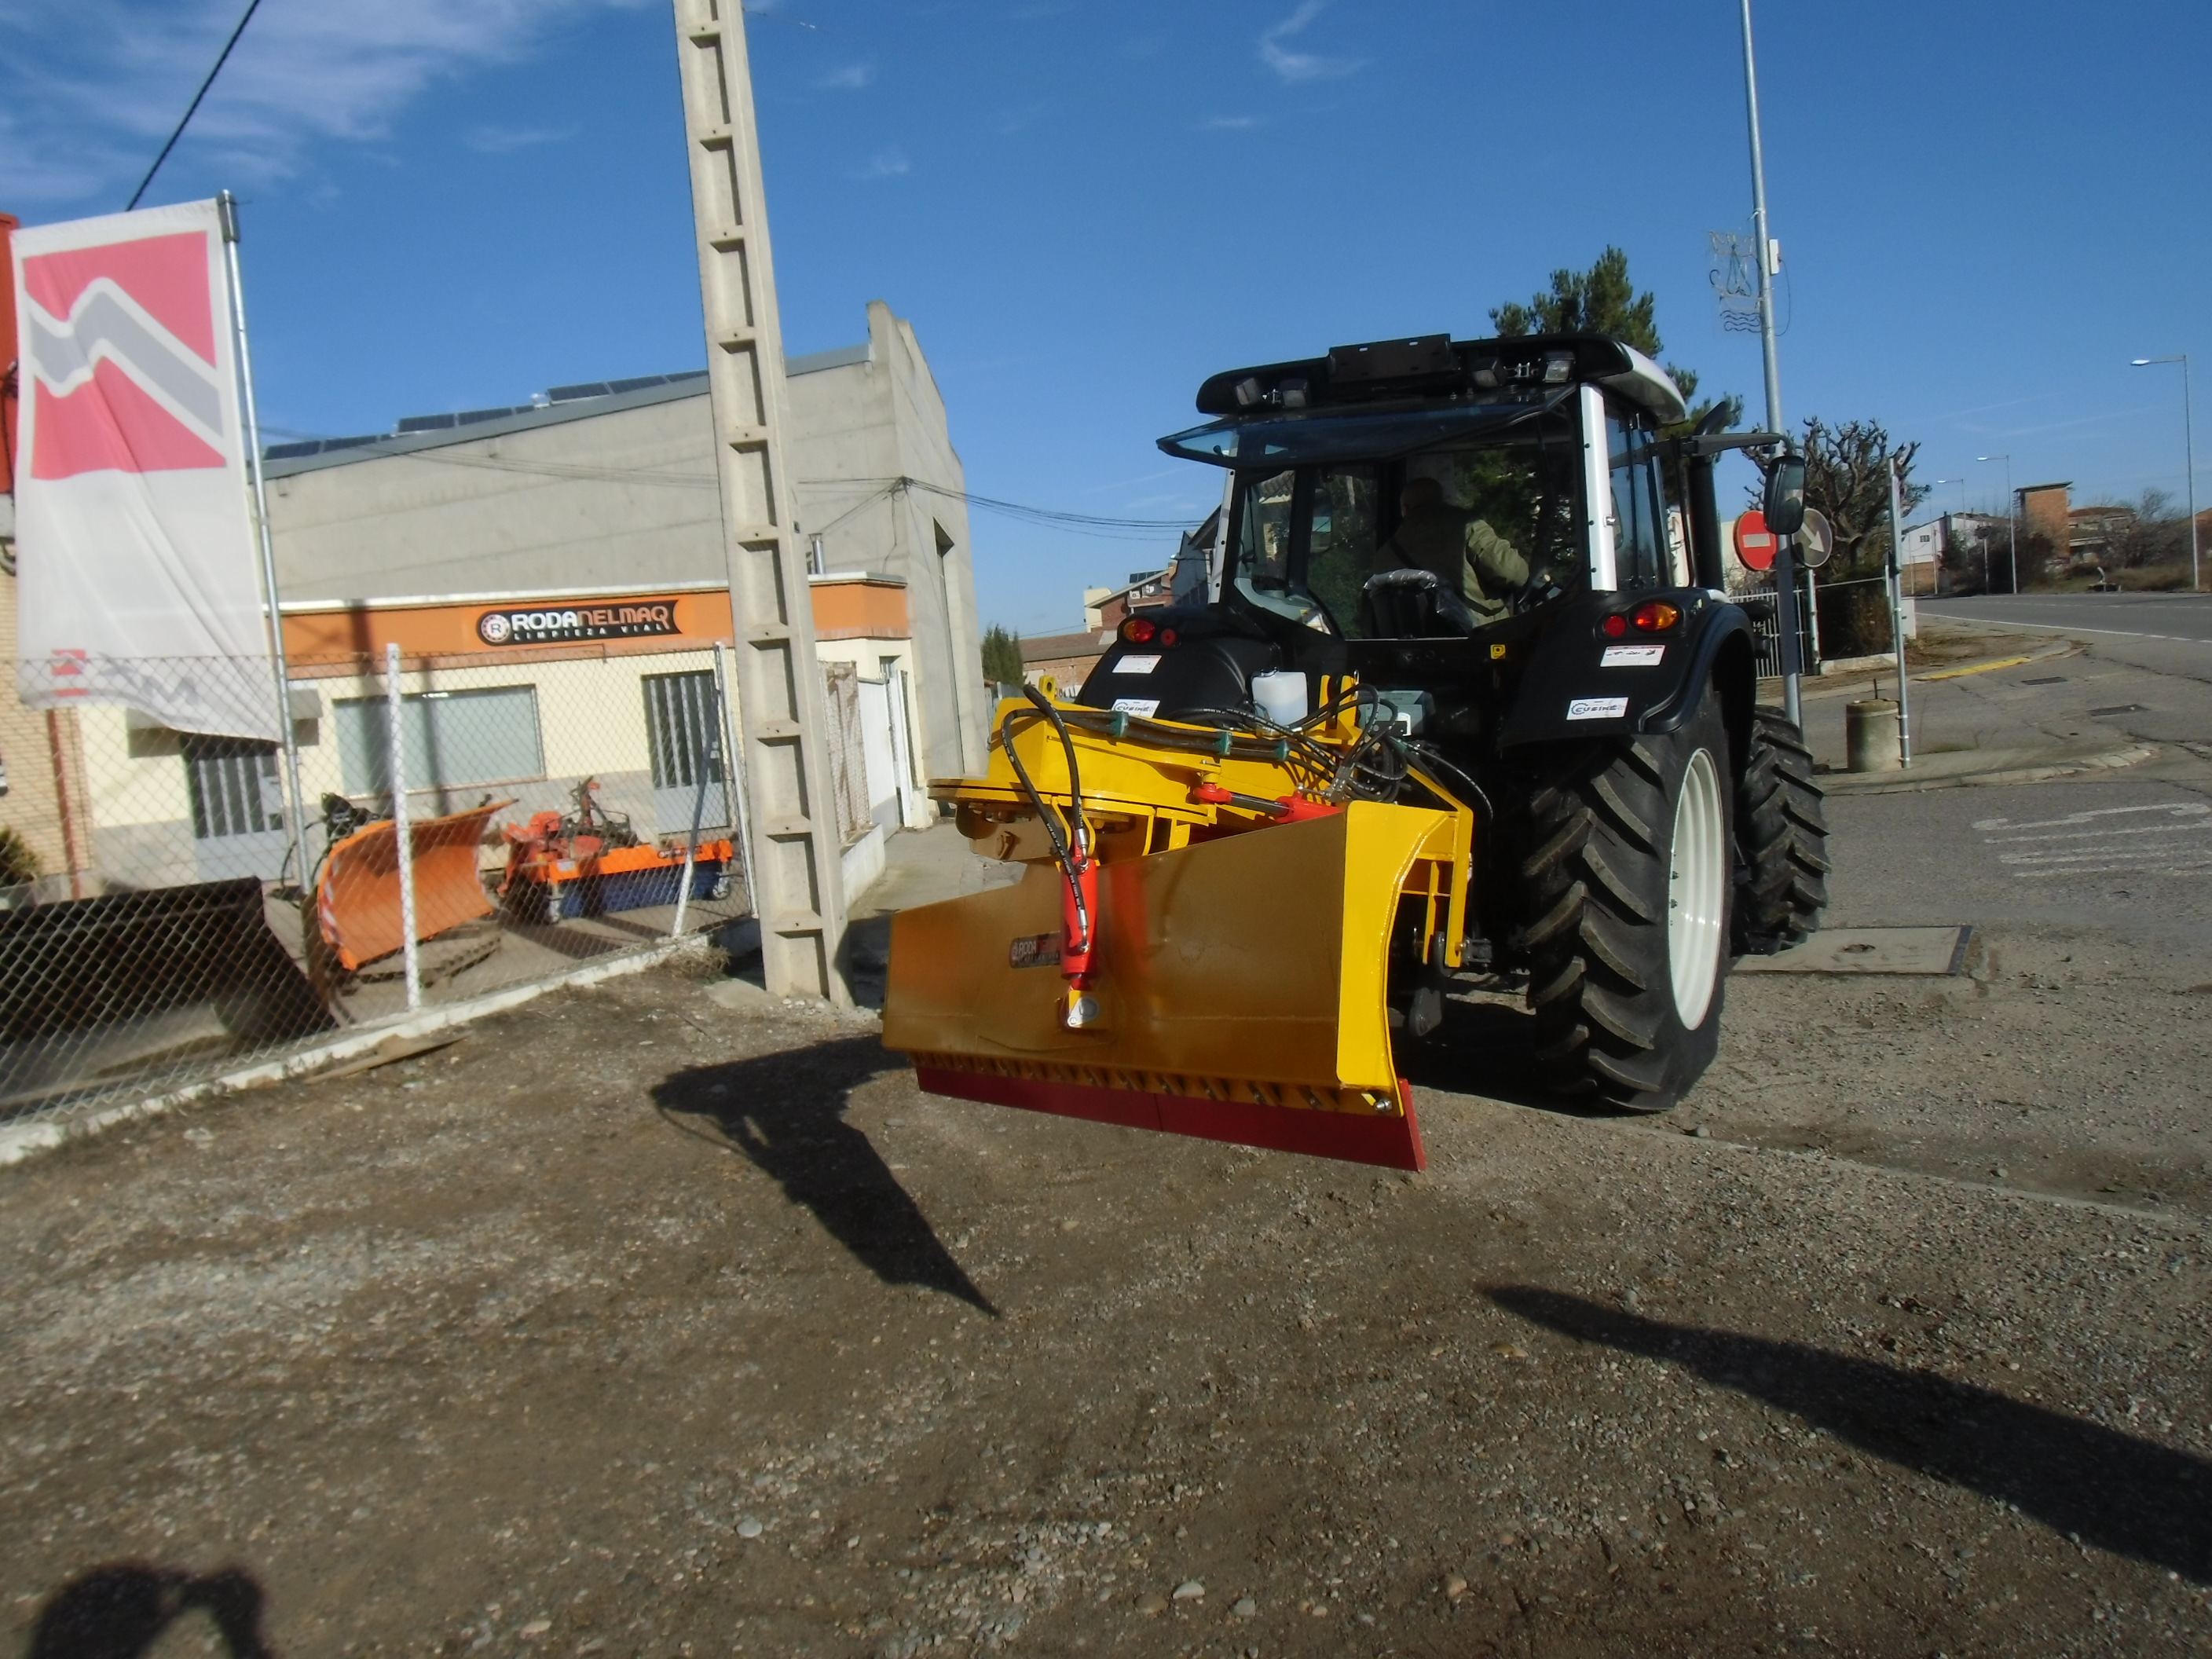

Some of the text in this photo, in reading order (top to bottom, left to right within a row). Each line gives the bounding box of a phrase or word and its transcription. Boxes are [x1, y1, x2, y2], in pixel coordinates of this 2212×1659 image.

[511, 606, 669, 629] RODANELMAQ
[515, 624, 662, 640] LIMPIEZA VIAL
